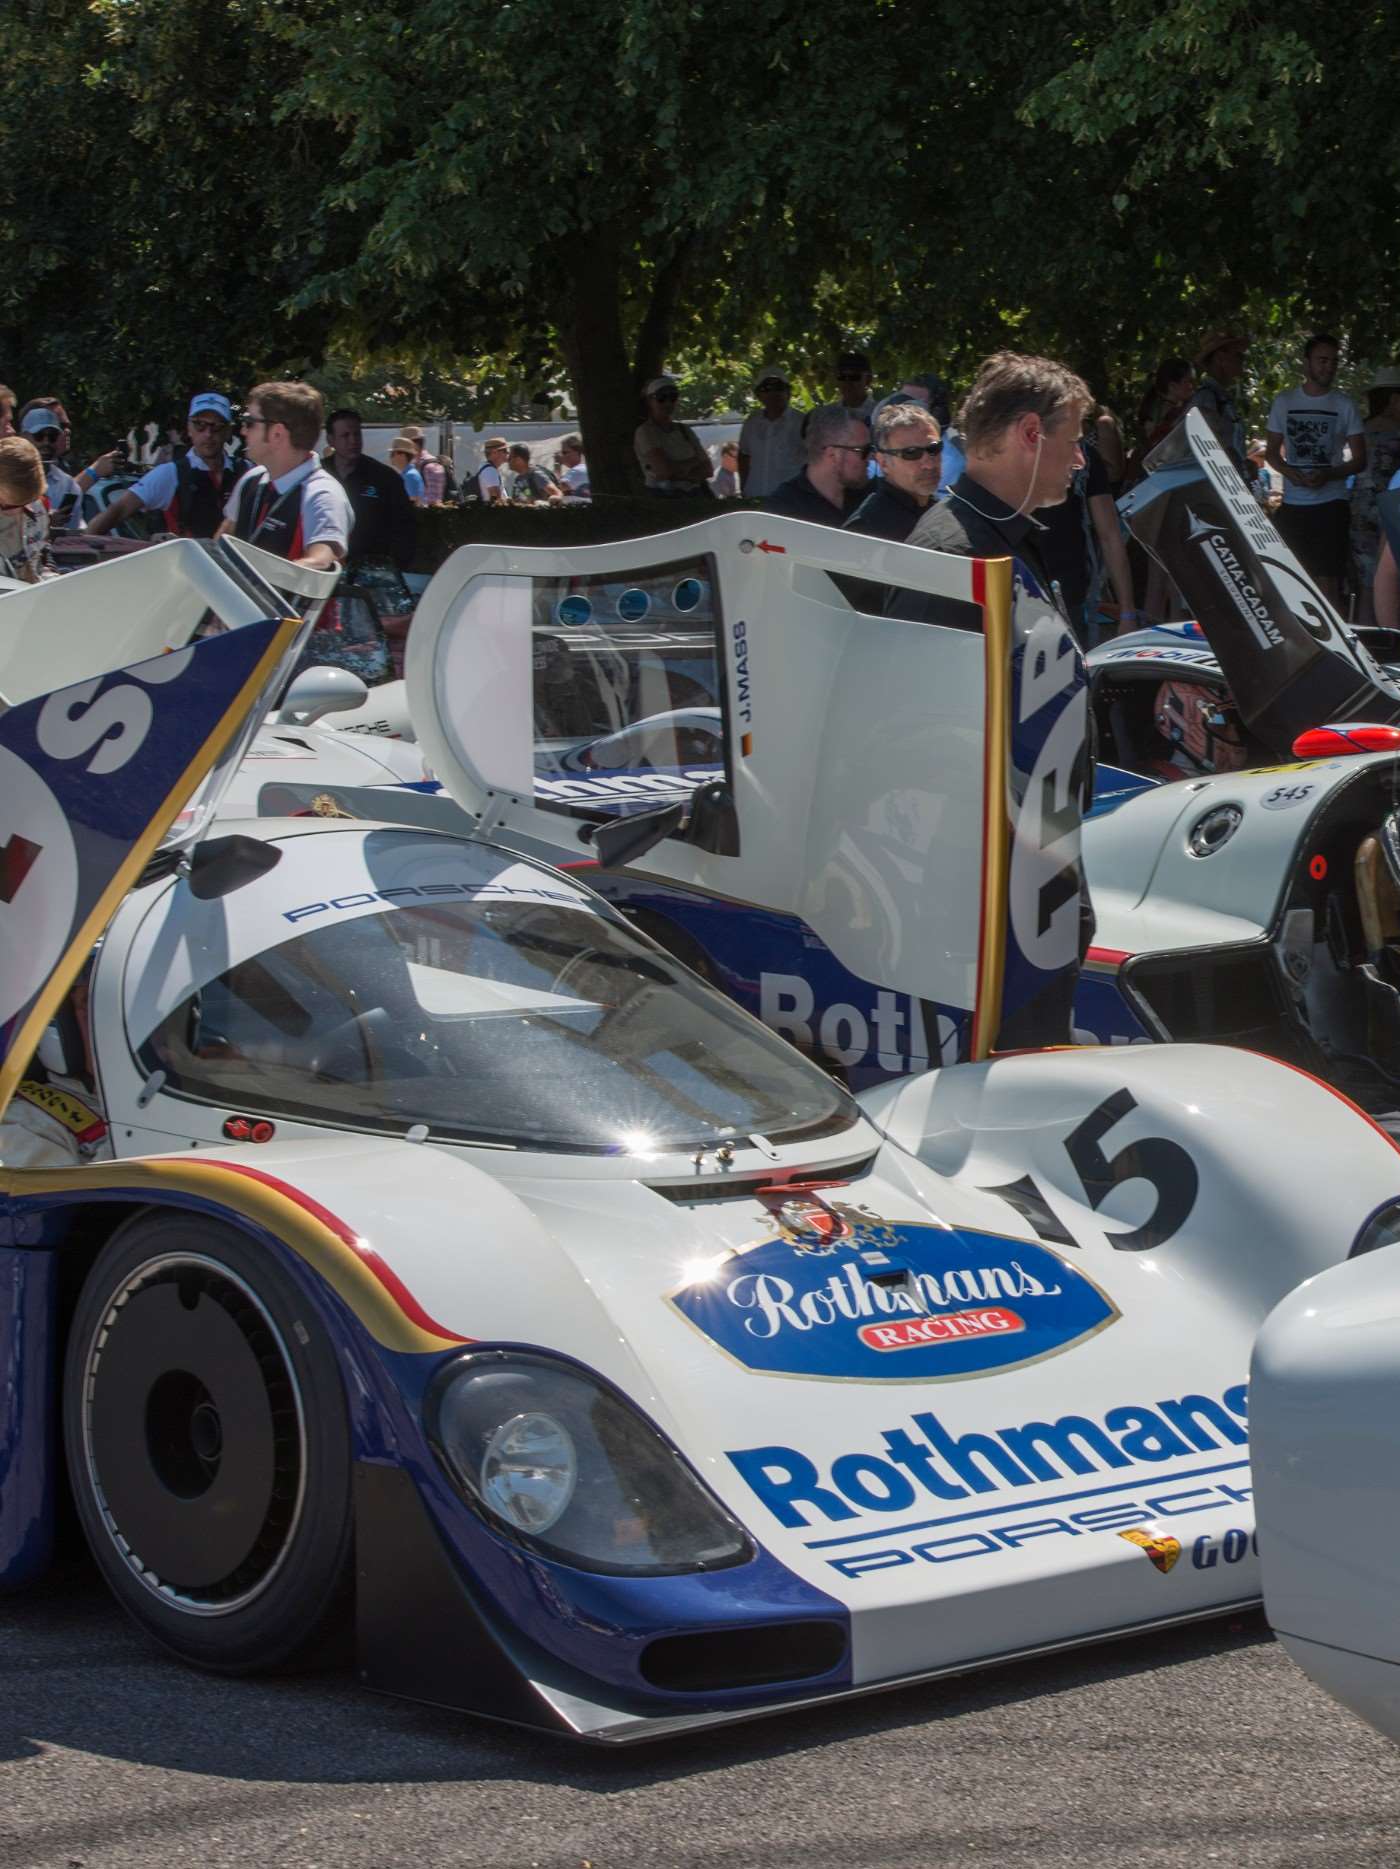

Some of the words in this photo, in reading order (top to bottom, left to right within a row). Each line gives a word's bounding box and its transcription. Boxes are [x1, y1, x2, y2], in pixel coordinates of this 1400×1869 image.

[732, 620, 753, 722] J.MASS
[1267, 784, 1315, 802] 545
[282, 883, 586, 923] PORSCHE
[974, 1087, 1200, 1252] 15
[726, 1260, 1063, 1338] Rothmans
[871, 1309, 1011, 1349] RACING
[825, 1484, 1253, 1579] PORSCH
